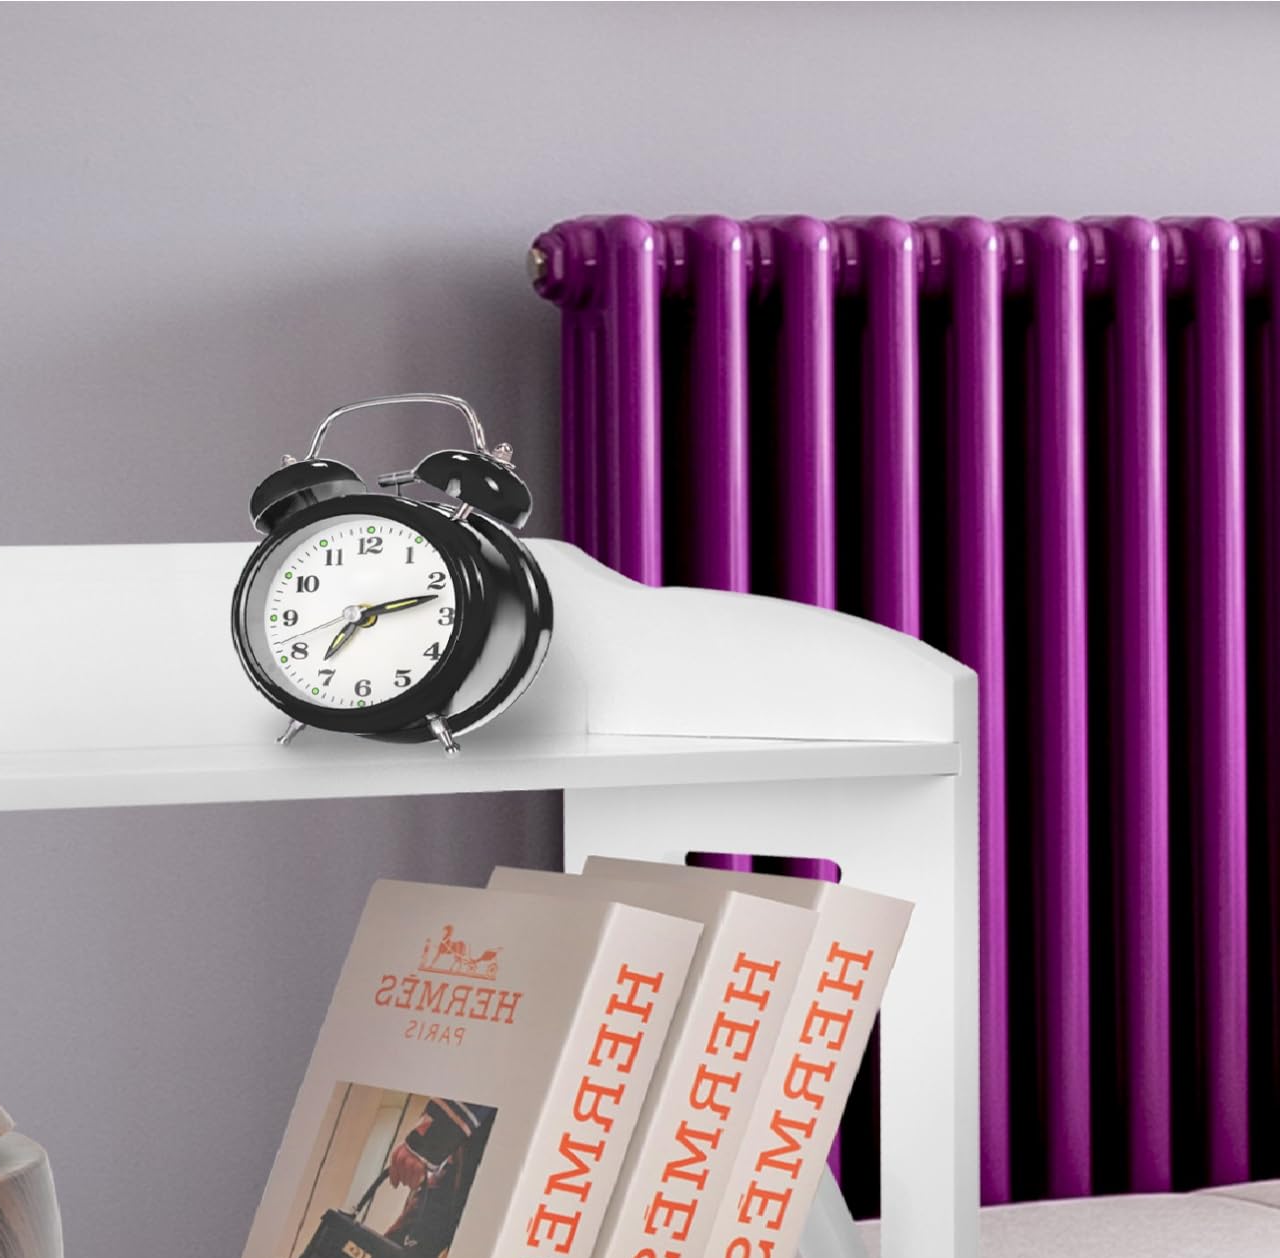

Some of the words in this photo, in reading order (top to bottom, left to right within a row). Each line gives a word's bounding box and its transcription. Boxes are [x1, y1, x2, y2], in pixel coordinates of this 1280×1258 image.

[357, 537, 383, 554] 12
[324, 549, 343, 566] 11
[405, 547, 414, 564] 1
[296, 575, 320, 593] 10
[427, 572, 446, 590] 2
[283, 609, 298, 626] 9
[438, 607, 454, 625] 3
[291, 642, 308, 659] 8
[423, 642, 441, 660] 4
[318, 669, 336, 686] 7
[394, 669, 412, 687] 5
[354, 679, 372, 697] 6
